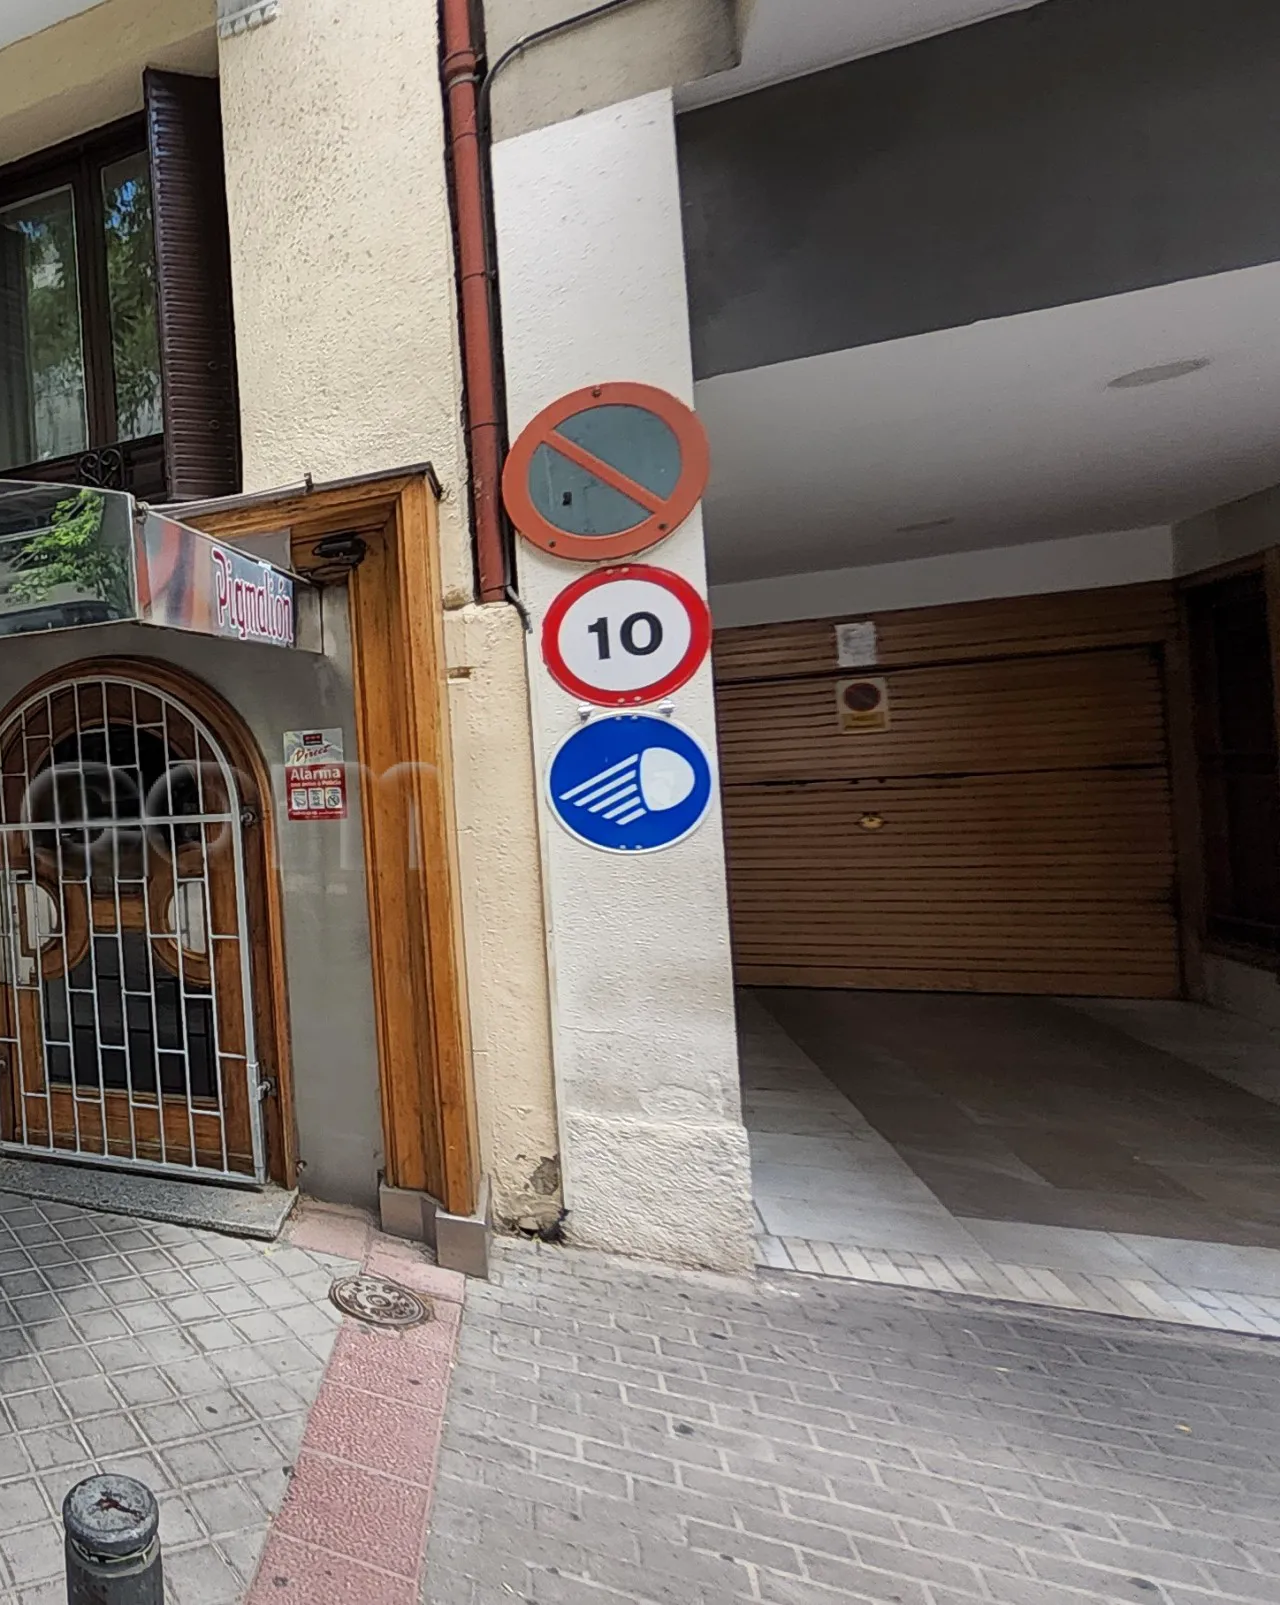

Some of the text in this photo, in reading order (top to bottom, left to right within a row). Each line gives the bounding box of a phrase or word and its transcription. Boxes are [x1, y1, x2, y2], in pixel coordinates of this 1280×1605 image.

[211, 546, 294, 643] Pigmalión
[587, 610, 664, 660] 10
[290, 767, 341, 781] Alarma
